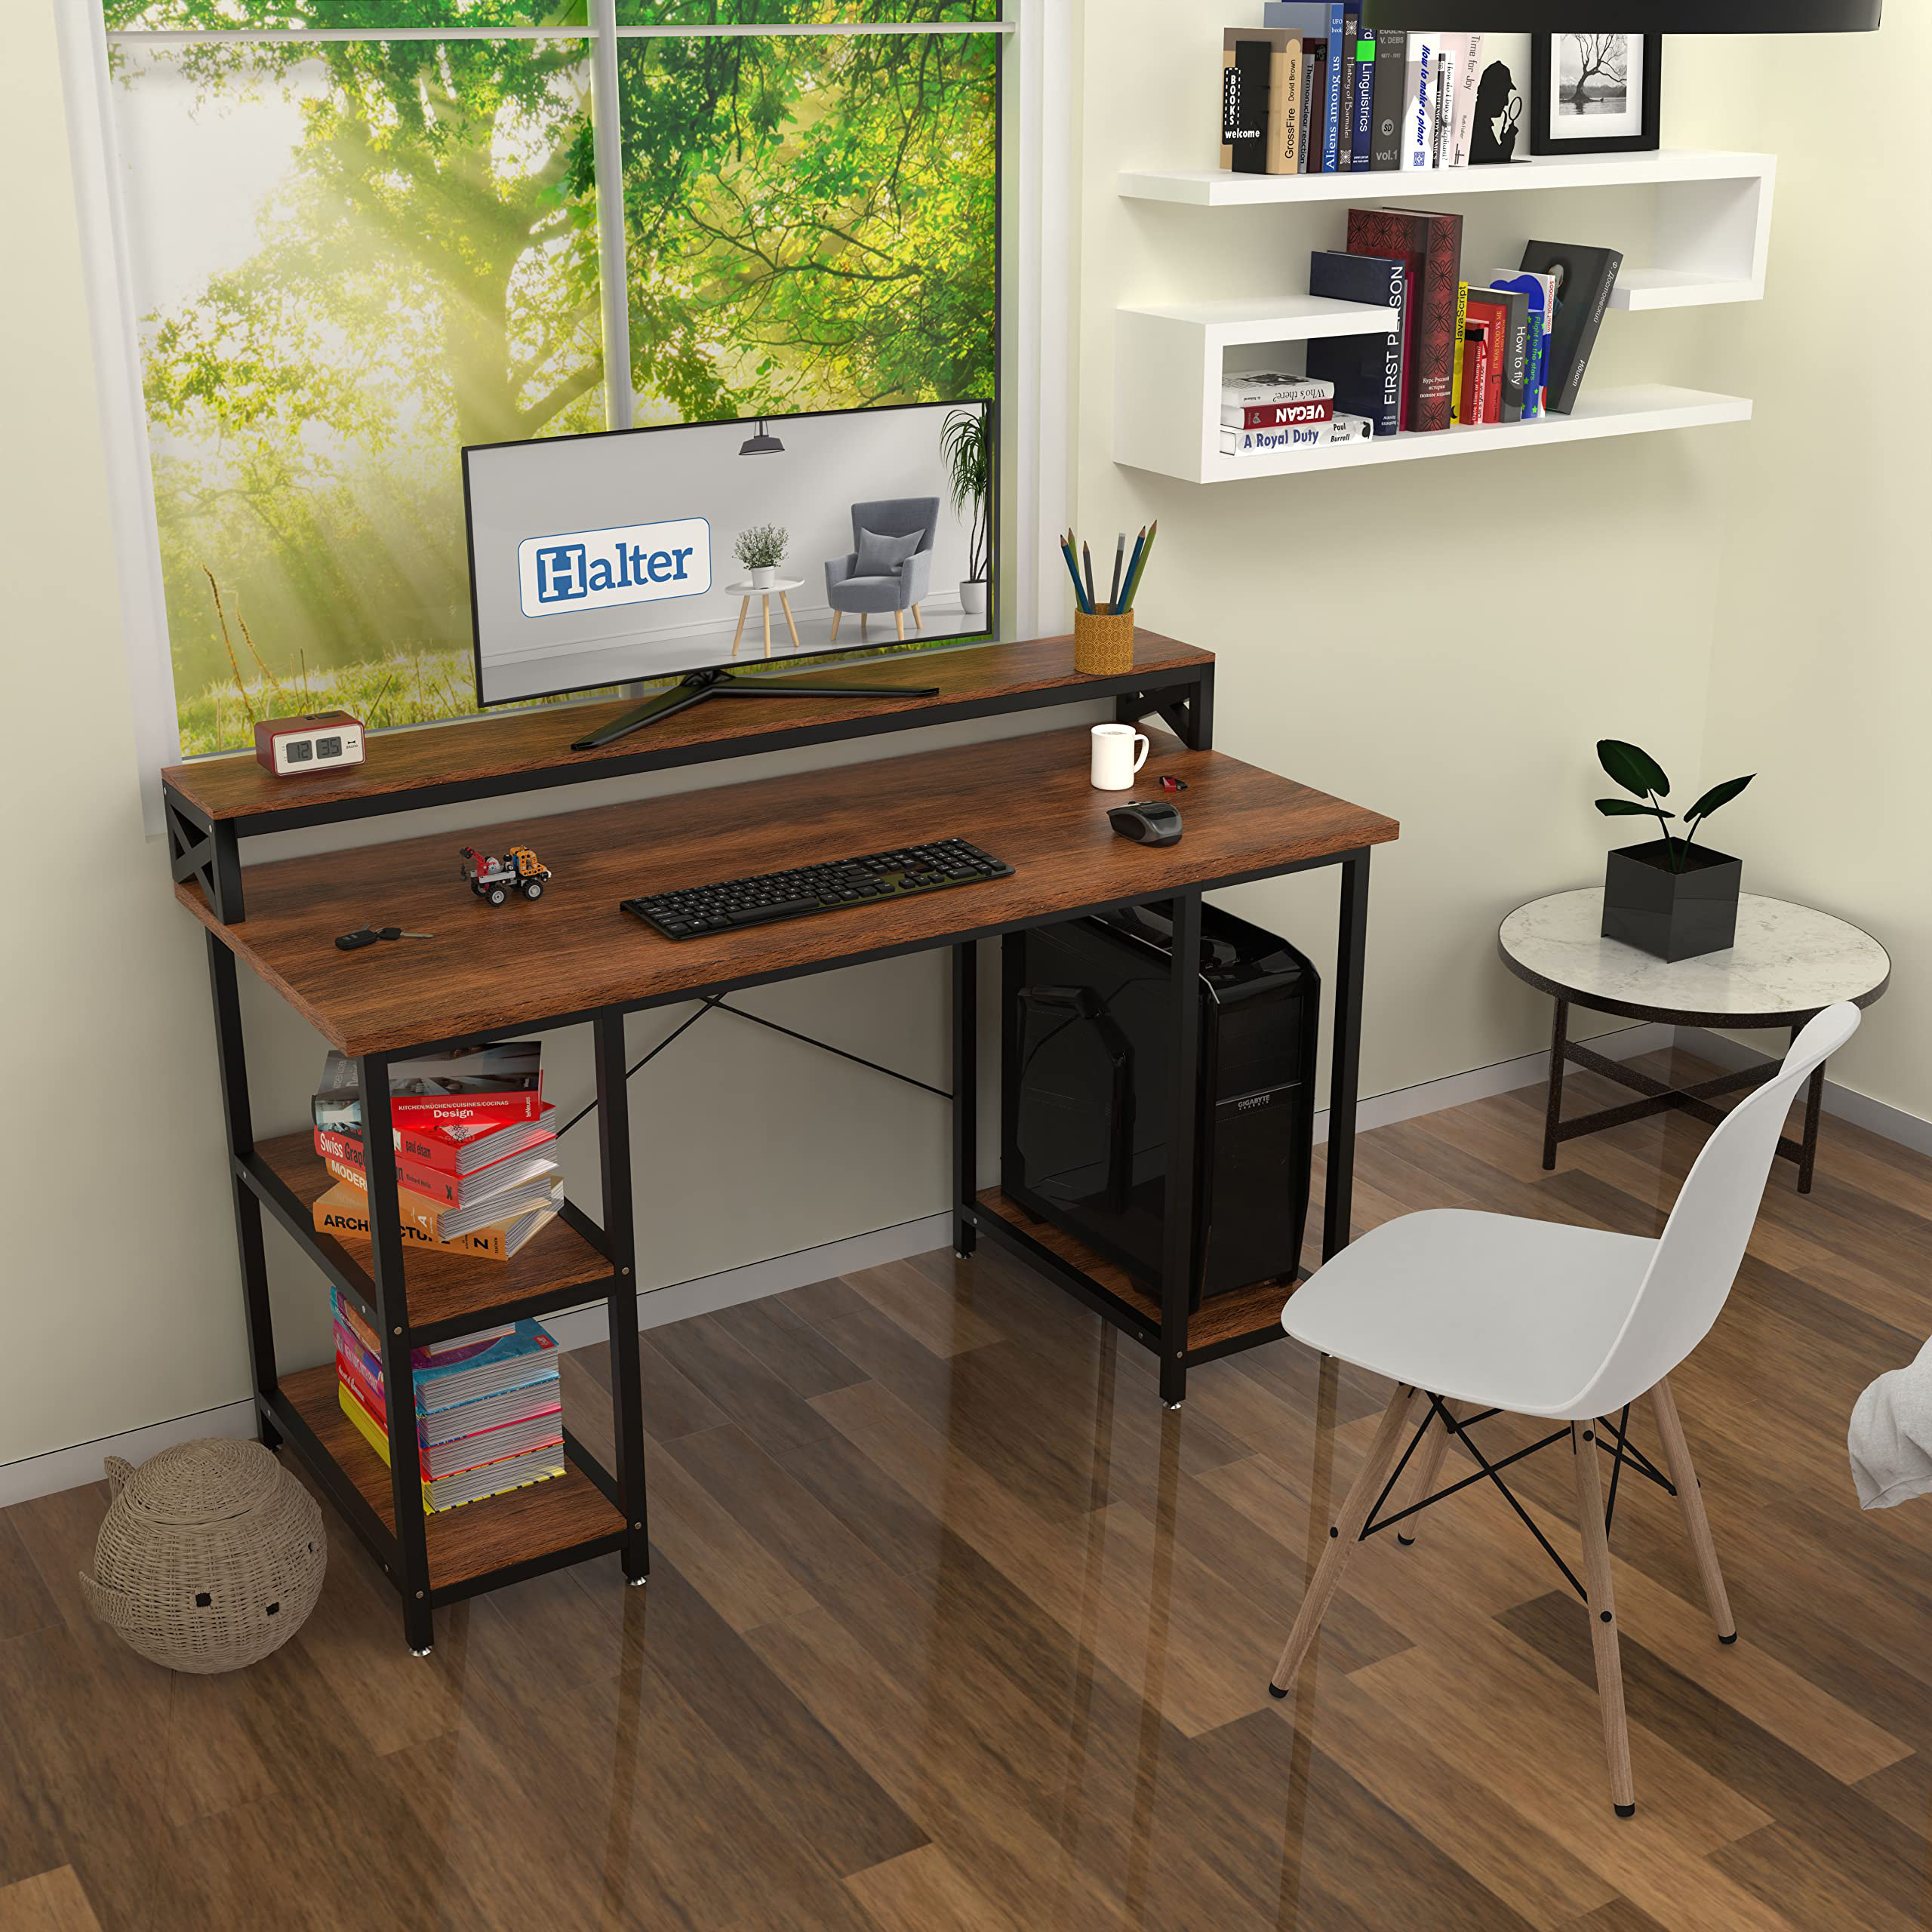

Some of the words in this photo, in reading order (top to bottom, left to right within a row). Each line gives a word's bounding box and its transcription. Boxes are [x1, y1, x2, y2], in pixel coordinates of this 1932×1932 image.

[1421, 45, 1430, 67] How
[1469, 36, 1481, 57] Time
[1333, 56, 1340, 71] us
[1344, 57, 1355, 89] History
[1420, 68, 1429, 79] to
[1467, 60, 1478, 72] for
[1463, 75, 1475, 90] Joy
[1303, 64, 1313, 128] Thermonuclear
[1330, 75, 1341, 122] among
[1346, 91, 1353, 103] of
[1358, 63, 1373, 132] Linguistrics
[1420, 80, 1428, 108] make
[1225, 128, 1260, 139] welcome
[1284, 108, 1296, 158] GrossFire
[1383, 124, 1392, 132] SD
[1417, 115, 1426, 146] plane
[1326, 126, 1337, 169] Aliens
[1376, 149, 1398, 161] vol.1
[1387, 266, 1403, 346] PSON
[1593, 270, 1614, 324] Достоевский
[1455, 285, 1467, 343] JavaScript
[1497, 311, 1502, 320] ME
[1532, 316, 1540, 337] Flight
[1515, 326, 1526, 353] How
[1514, 356, 1523, 368] to
[1572, 358, 1586, 387] Идиот
[1384, 351, 1398, 405] FIRST
[1511, 371, 1522, 385] fly
[1272, 390, 1298, 402] there?
[1300, 389, 1325, 400] Who's
[1275, 404, 1325, 423] VEGAN
[1330, 433, 1350, 443] Burrell
[1333, 423, 1346, 432] Paul
[1243, 434, 1252, 448] A
[1256, 429, 1288, 450] Royal
[1293, 429, 1319, 445] Duty
[537, 542, 694, 601] Halter
[297, 743, 310, 759] 12
[320, 738, 339, 755] 35
[1238, 1094, 1270, 1108] GIGABYTE
[433, 1109, 474, 1118] Design
[320, 1133, 343, 1158] Swiss
[405, 1140, 416, 1154] paul
[331, 1160, 368, 1192] MODER
[417, 1215, 427, 1228] A
